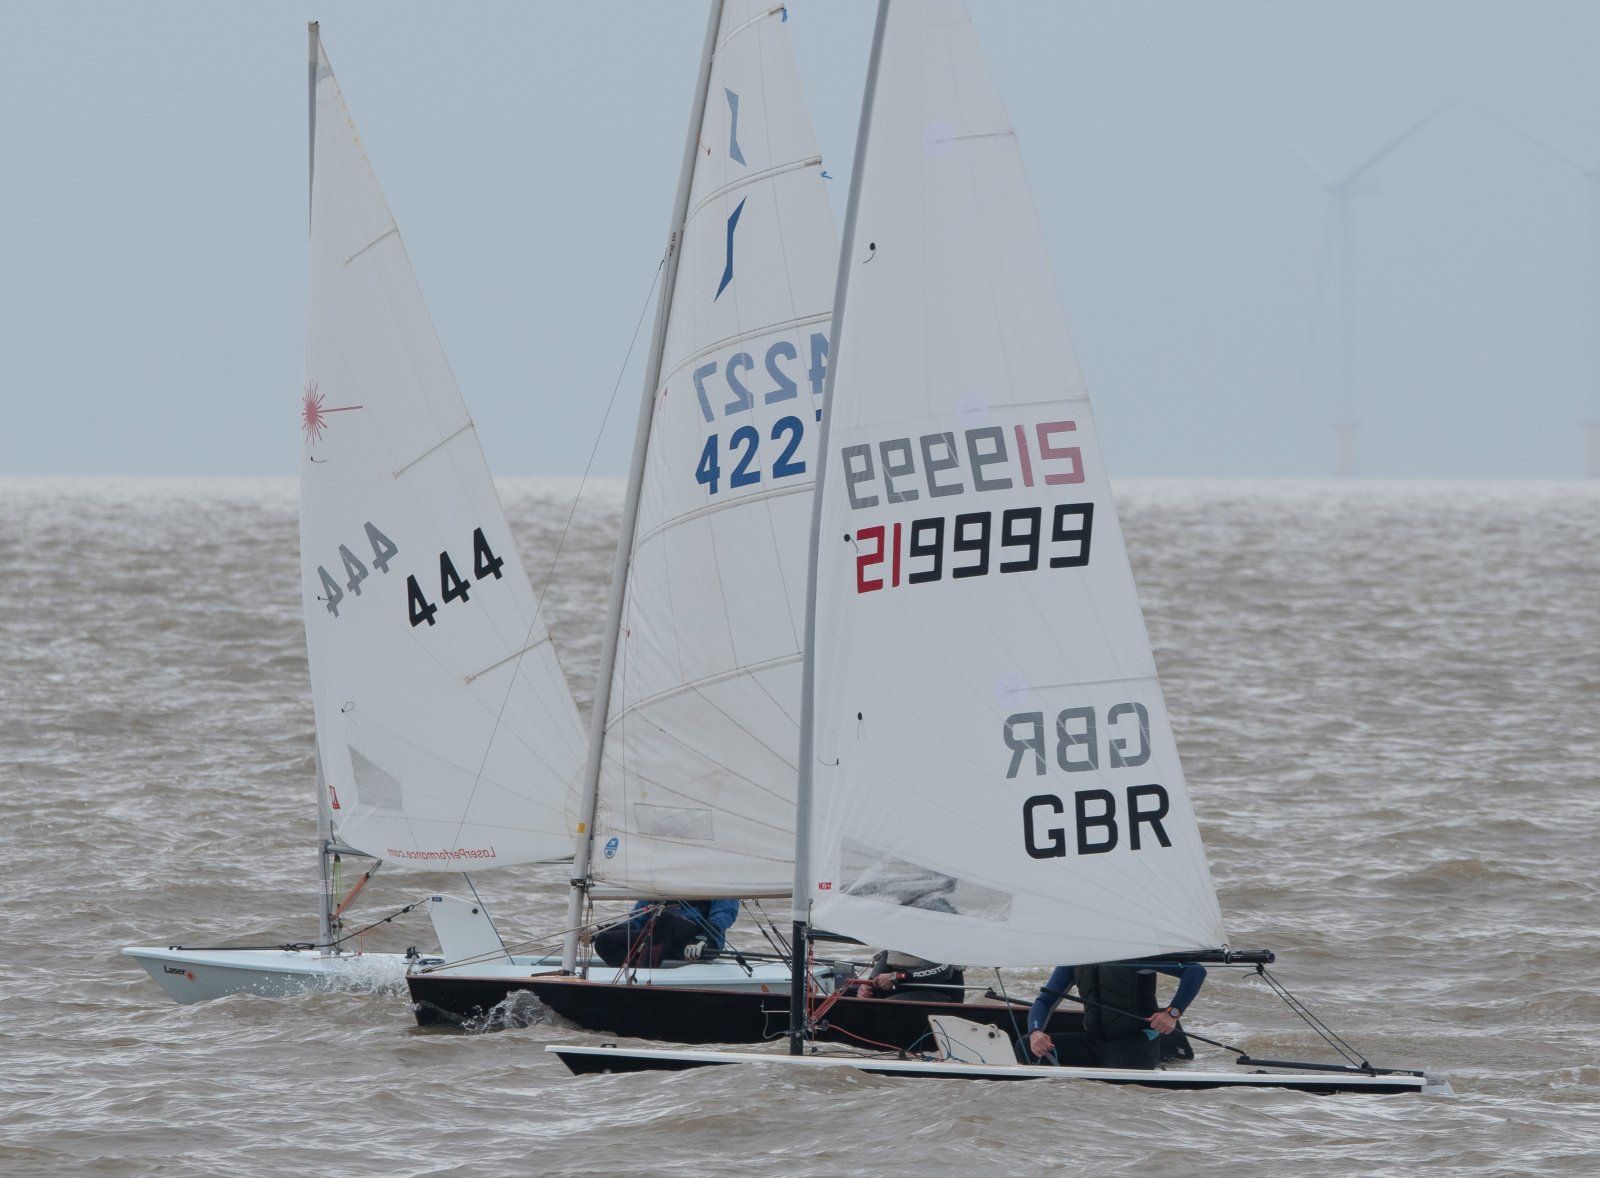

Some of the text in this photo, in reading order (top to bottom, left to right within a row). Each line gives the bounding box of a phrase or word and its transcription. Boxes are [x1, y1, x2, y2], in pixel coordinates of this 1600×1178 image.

[695, 409, 822, 495] 422
[407, 527, 504, 627] 444
[856, 503, 1094, 593] 219999
[1023, 784, 1172, 859] GBR
[163, 965, 186, 976] Laser
